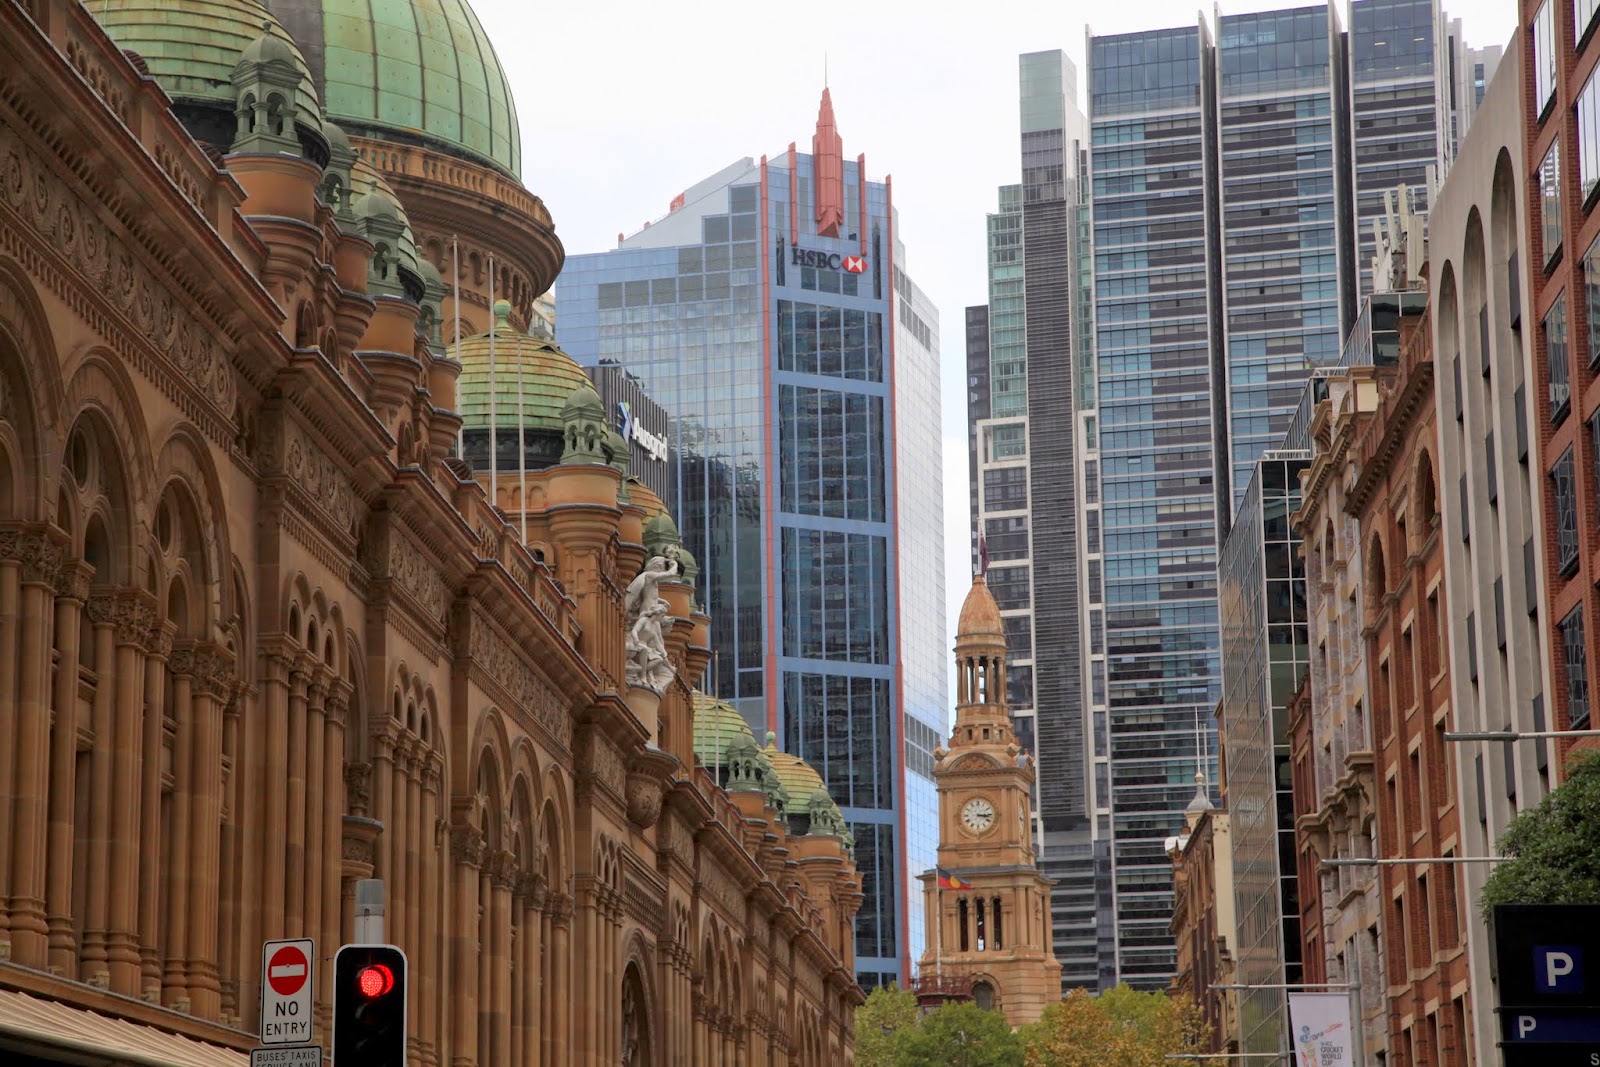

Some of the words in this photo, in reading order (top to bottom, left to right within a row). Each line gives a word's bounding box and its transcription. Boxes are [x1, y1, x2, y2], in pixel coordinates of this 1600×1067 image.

[792, 248, 841, 270] HSBC
[632, 417, 668, 462] Ausgrid
[1546, 952, 1574, 986] P
[275, 1001, 299, 1017] NO
[266, 1021, 307, 1036] ENTRY
[1518, 1015, 1537, 1039] P
[256, 1052, 286, 1062] BUSES
[291, 1050, 316, 1060] TAXIS
